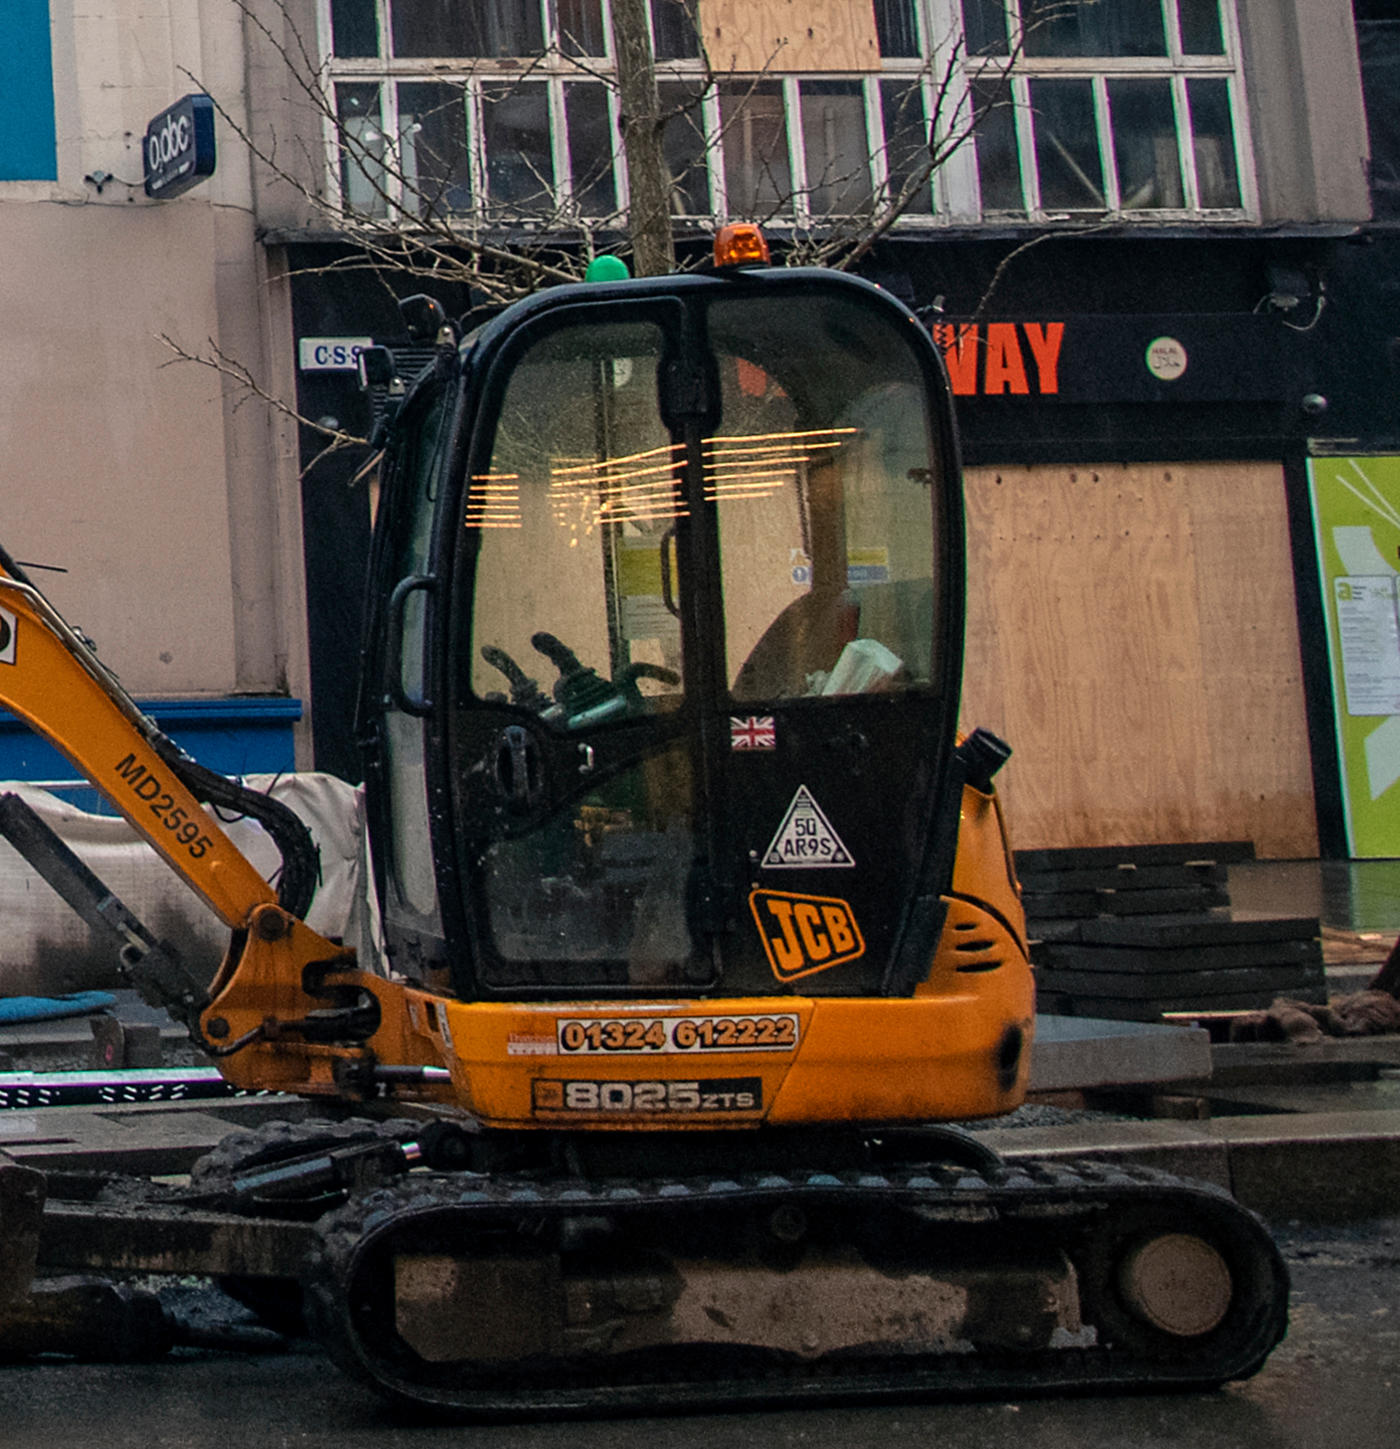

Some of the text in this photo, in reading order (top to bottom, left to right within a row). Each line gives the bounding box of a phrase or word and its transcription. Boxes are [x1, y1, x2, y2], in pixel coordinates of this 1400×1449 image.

[115, 753, 213, 859] MD2595
[784, 838, 832, 857] AR9S
[767, 899, 855, 970] JCB
[561, 1021, 666, 1051] 01324
[671, 1017, 796, 1050] 612222
[566, 1082, 701, 1110] 8025
[702, 1092, 755, 1108] ZTS
